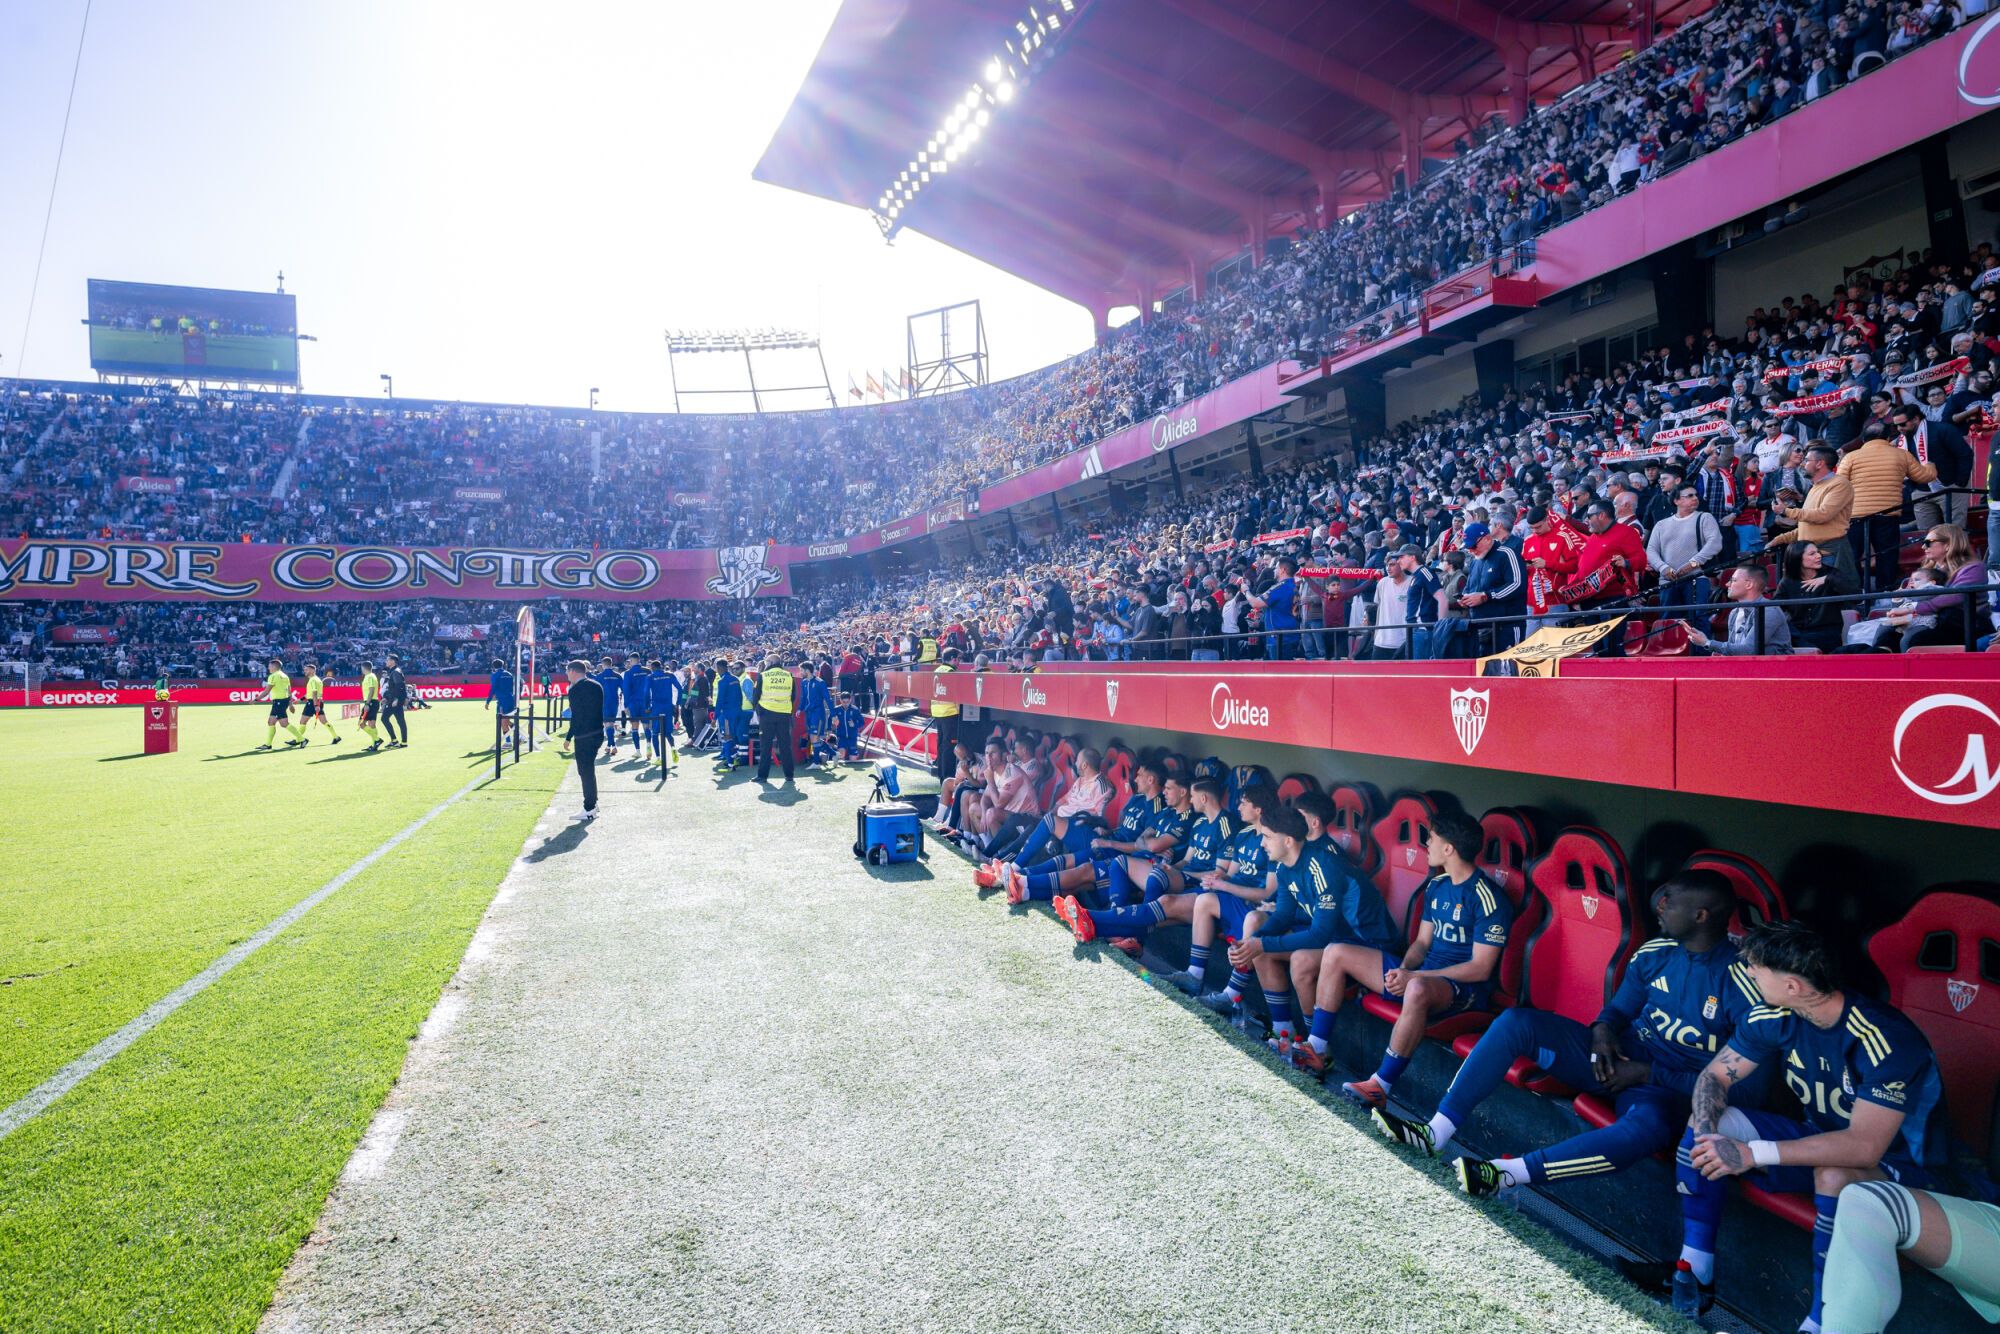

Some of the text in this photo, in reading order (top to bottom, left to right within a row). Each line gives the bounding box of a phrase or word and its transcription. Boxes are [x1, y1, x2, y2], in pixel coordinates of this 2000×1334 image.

[1152, 414, 1197, 451] Midea
[1656, 430, 1679, 439] UNCA
[129, 476, 171, 491] Midea
[455, 489, 501, 499] Cruzcampo
[808, 541, 848, 557] Cruzcampo
[274, 548, 659, 590] CONTIGO
[42, 691, 118, 705] eurotex
[229, 690, 299, 702] eurx
[1022, 677, 1046, 708] Midea
[1211, 682, 1269, 730] Midea
[1442, 902, 1450, 910] 27
[1786, 1068, 1852, 1120] DIG
